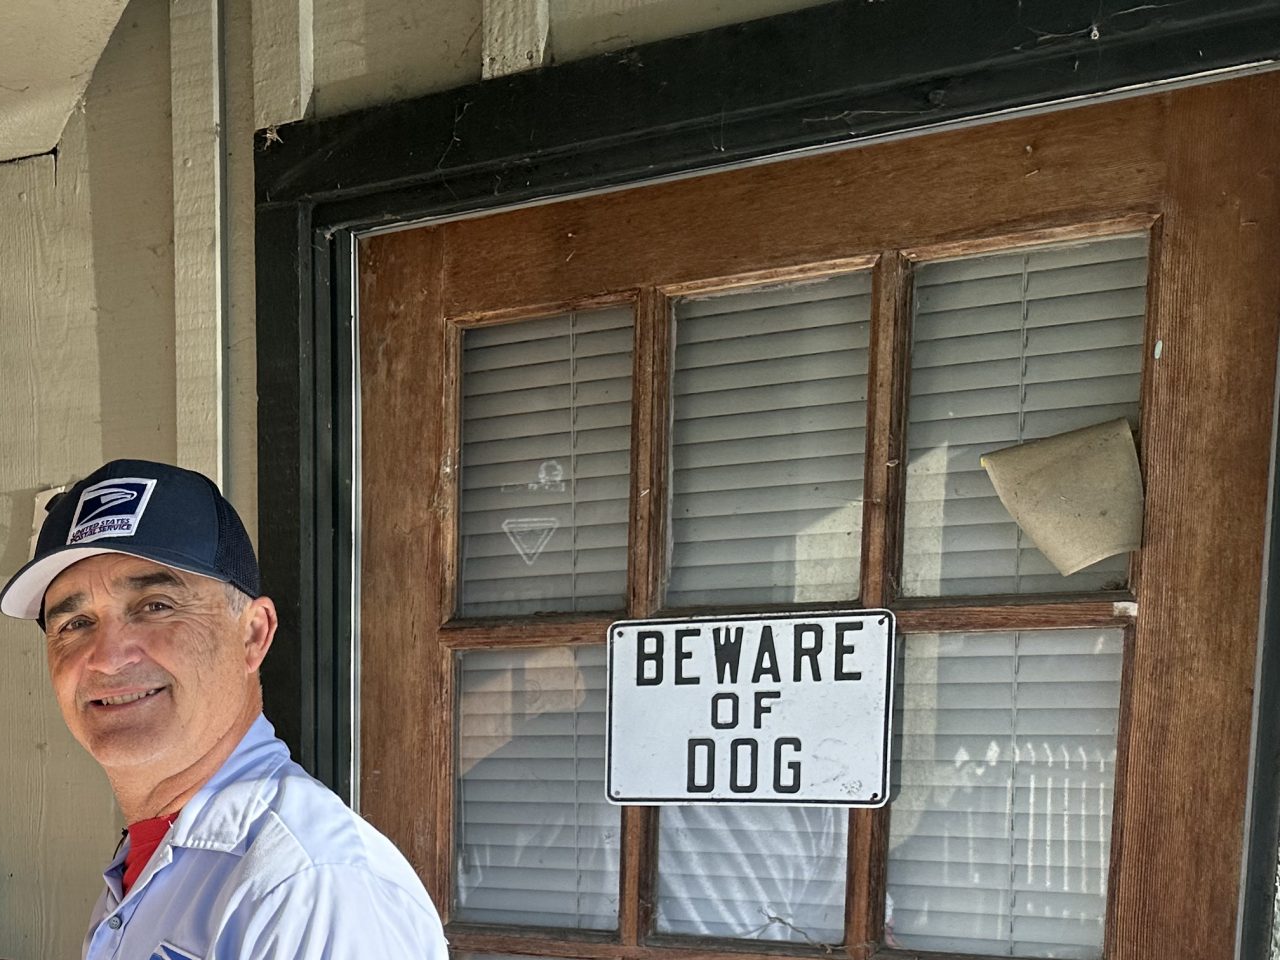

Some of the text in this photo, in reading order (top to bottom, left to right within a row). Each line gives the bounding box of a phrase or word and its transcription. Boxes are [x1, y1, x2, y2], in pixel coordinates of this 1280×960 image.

[70, 524, 132, 544] POSTAL SERVICE
[72, 518, 130, 538] UNITED STATES
[636, 621, 864, 686] BEWARE
[711, 691, 781, 730] OF
[686, 737, 802, 794] DOG
